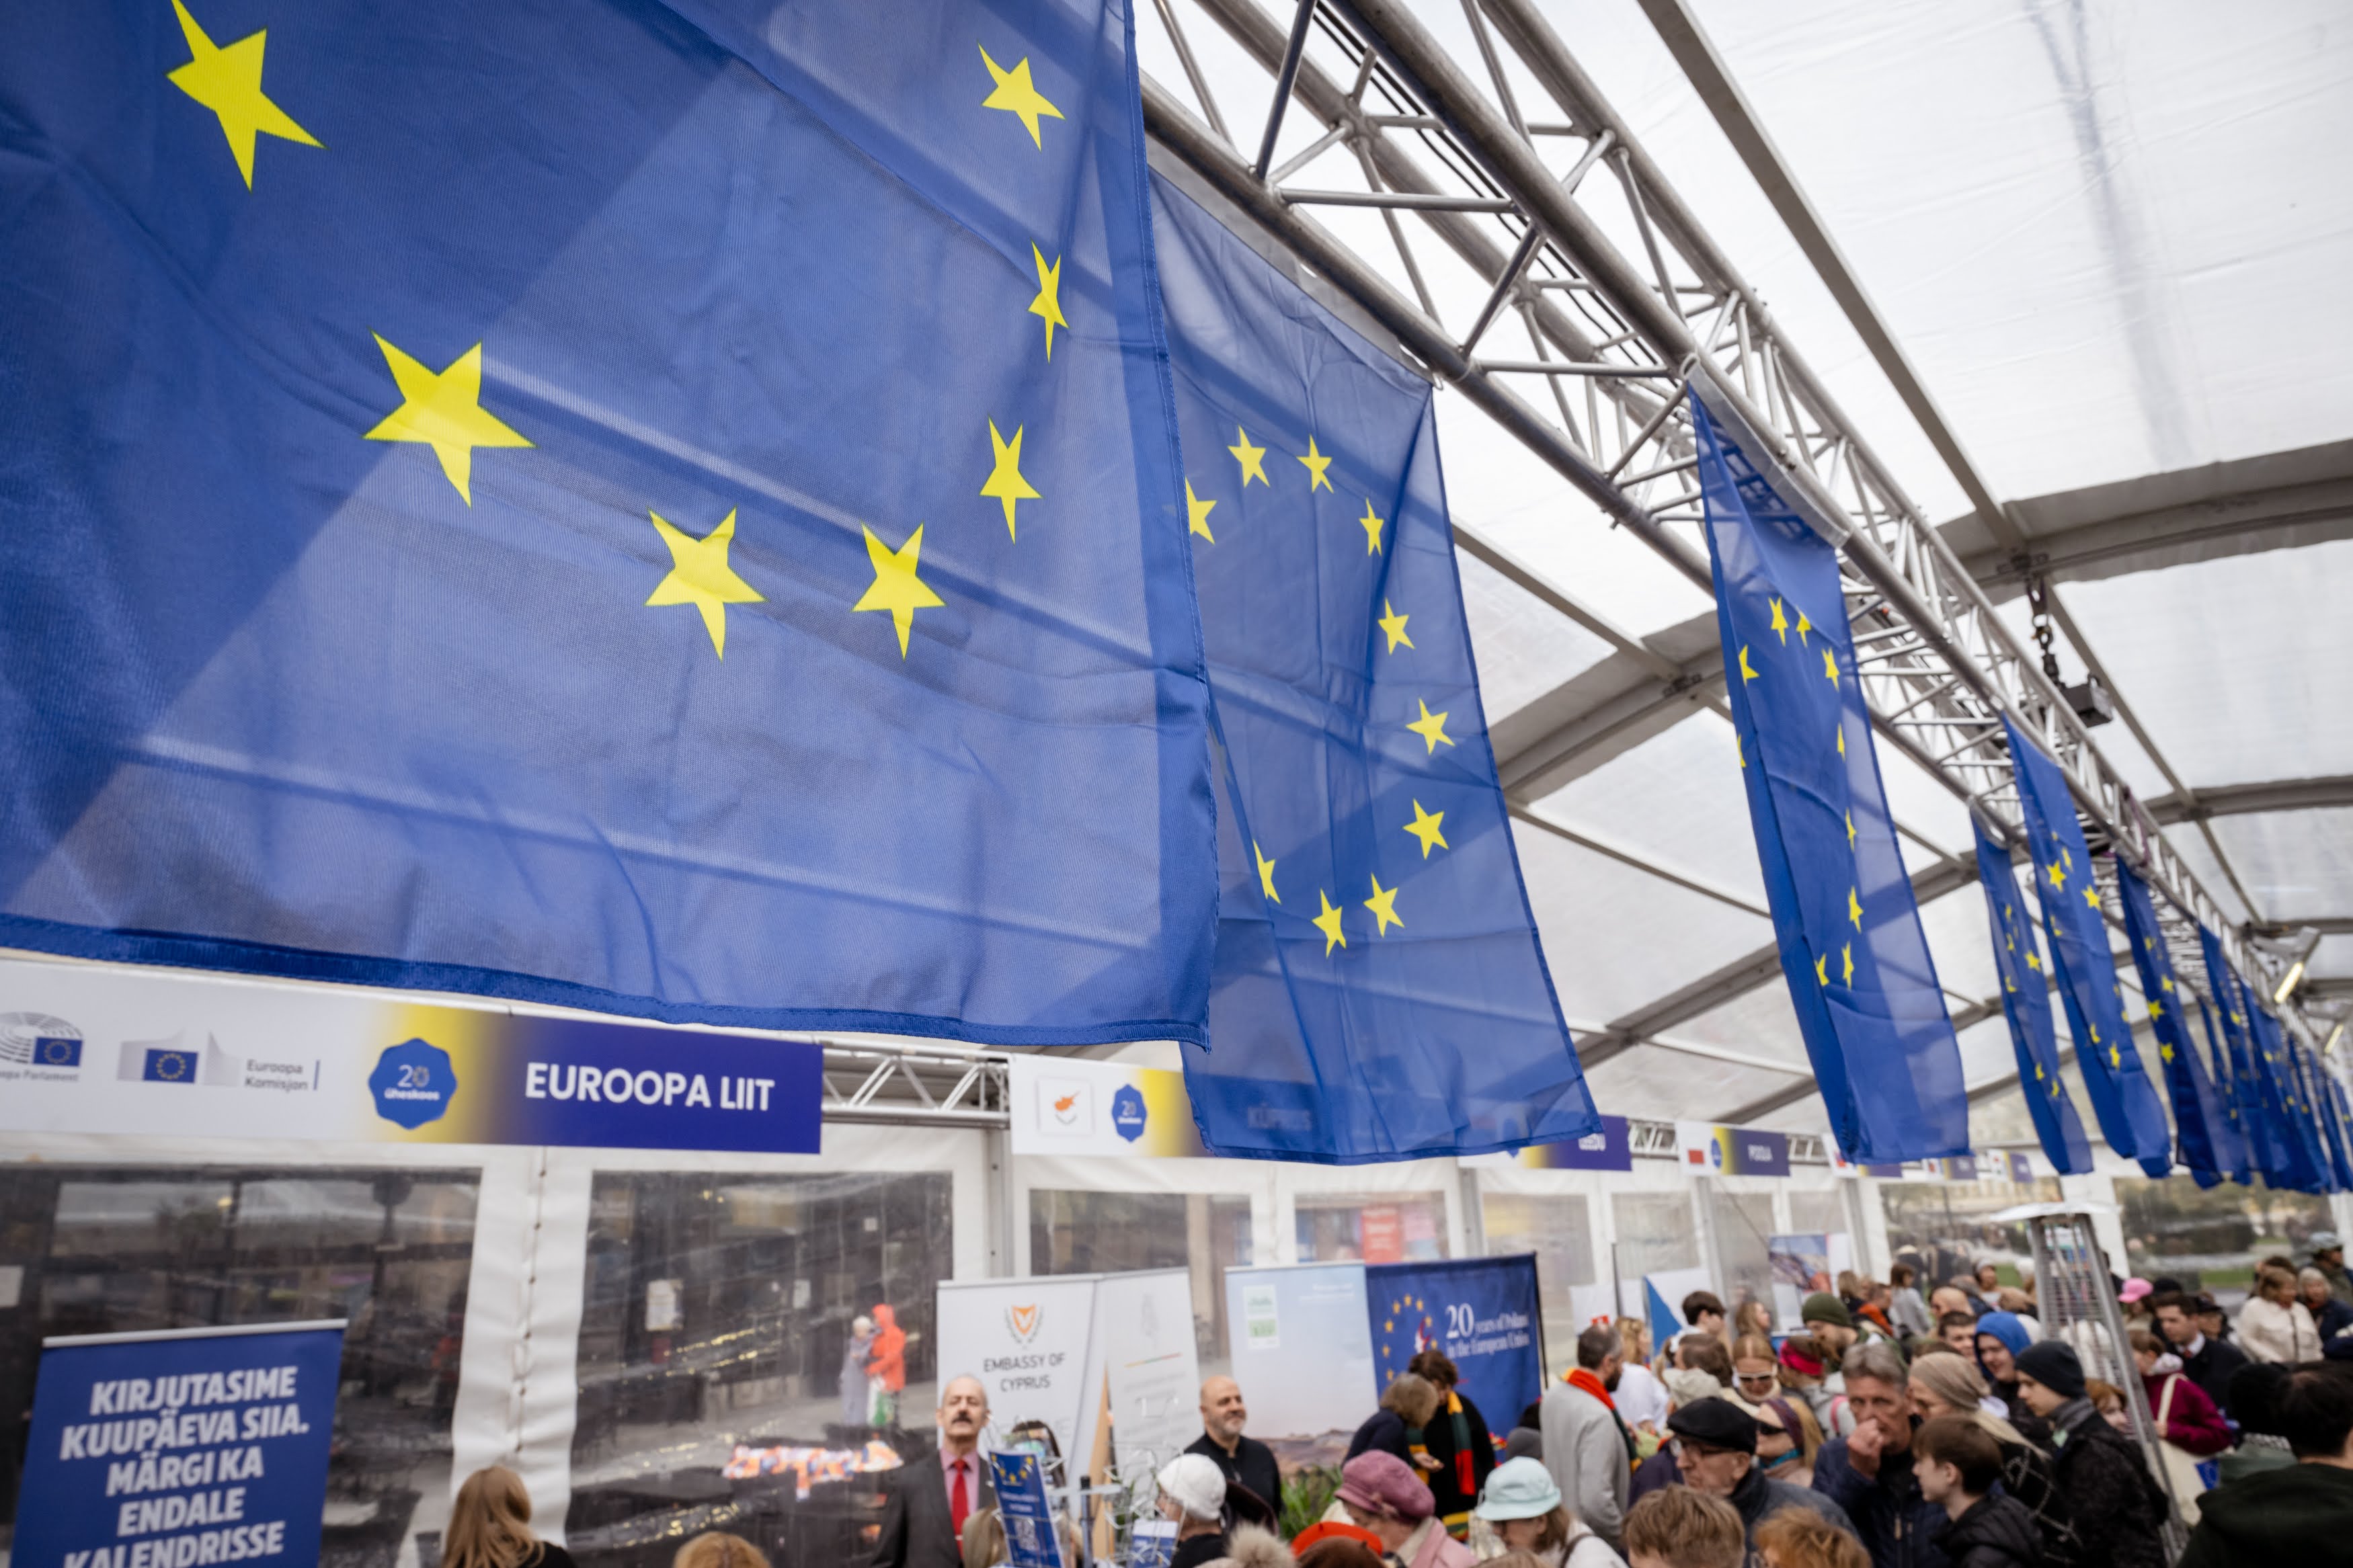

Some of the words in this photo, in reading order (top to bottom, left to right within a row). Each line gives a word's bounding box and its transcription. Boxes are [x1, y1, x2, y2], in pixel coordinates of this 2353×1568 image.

[245, 1077, 308, 1094] Komisjon
[247, 1059, 303, 1075] Euroopa
[525, 1062, 711, 1108] EUROOPA
[720, 1077, 775, 1111] LIIT
[1446, 1303, 1474, 1339] 20
[984, 1355, 1045, 1372] EMBASSY
[1049, 1352, 1066, 1366] OF
[90, 1366, 298, 1416] KIRJUTASIME
[1000, 1374, 1051, 1393] CYPRUS
[59, 1408, 237, 1460] KUUPÄEVA
[241, 1403, 311, 1440] SIIA.
[106, 1450, 214, 1497] MÄRGI
[218, 1446, 264, 1483] KA
[116, 1487, 246, 1537] ENDALE
